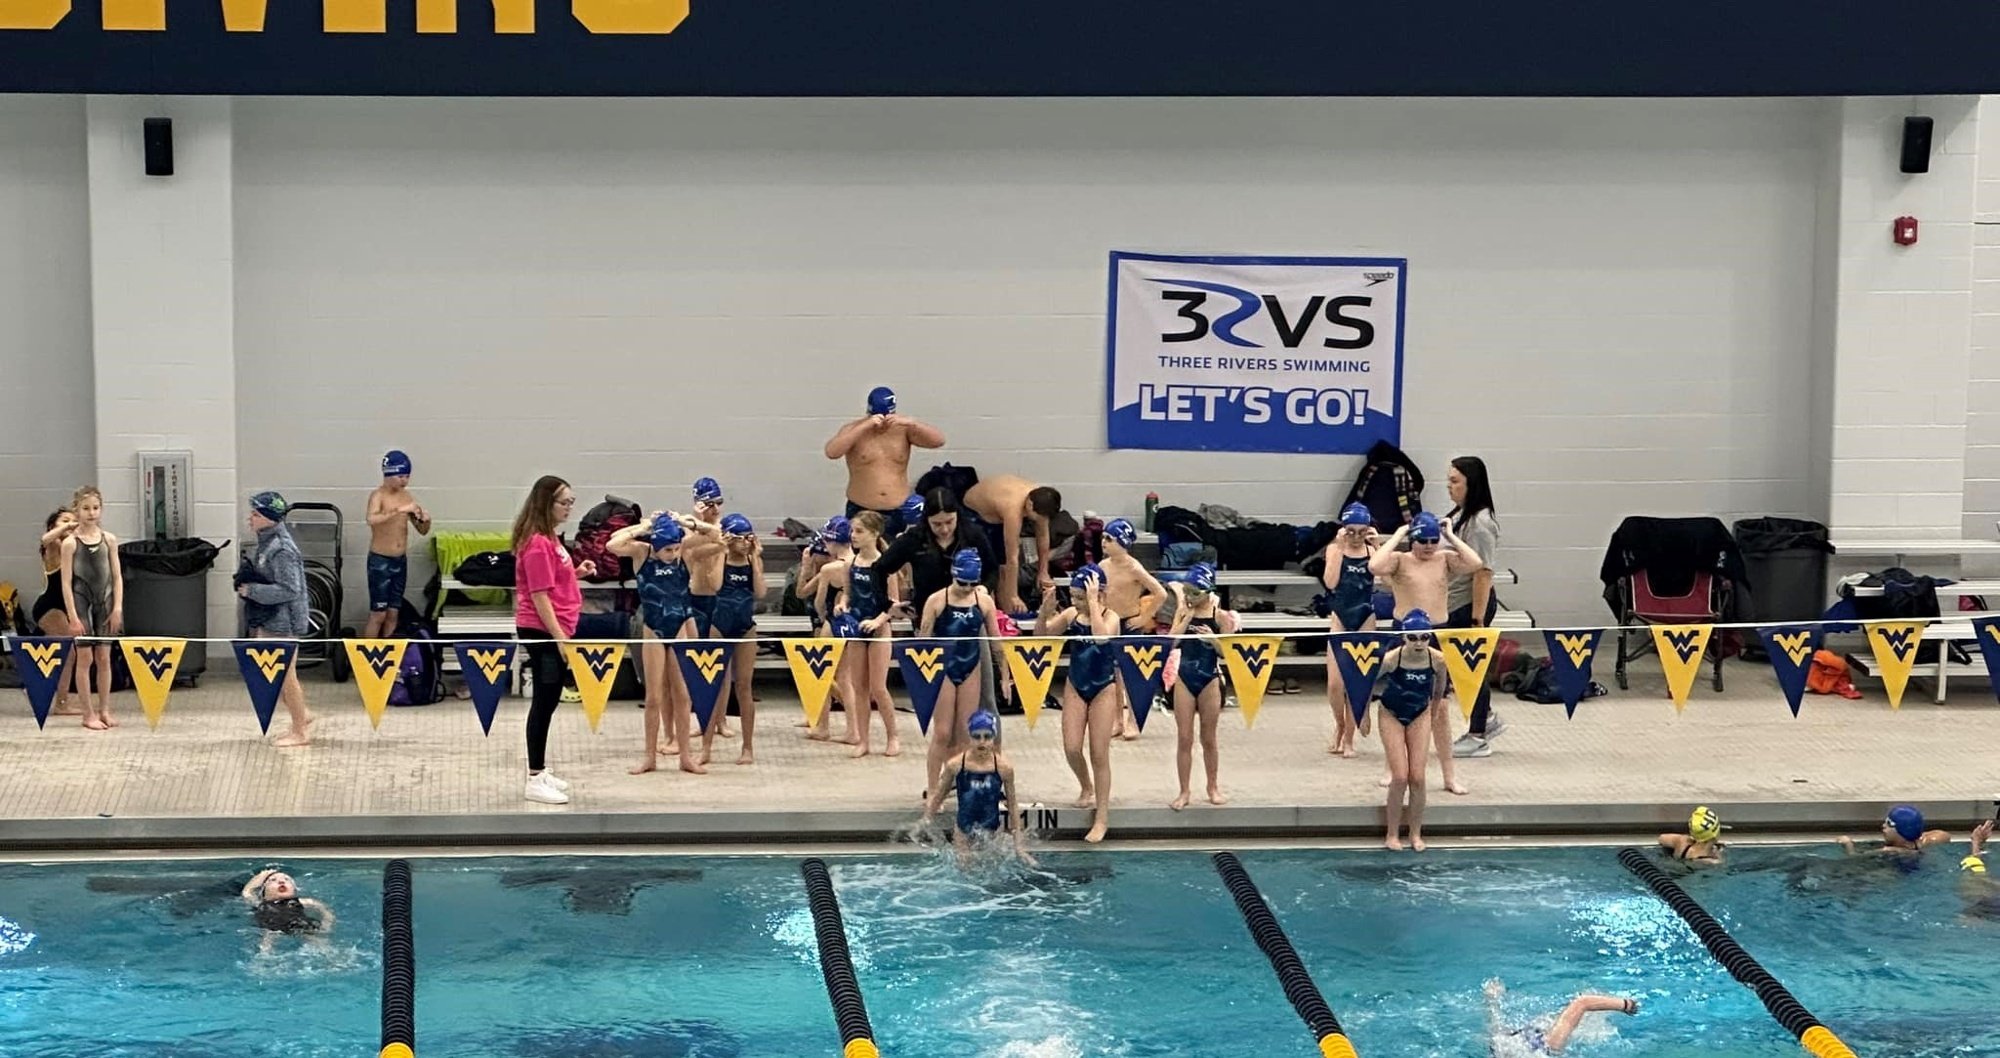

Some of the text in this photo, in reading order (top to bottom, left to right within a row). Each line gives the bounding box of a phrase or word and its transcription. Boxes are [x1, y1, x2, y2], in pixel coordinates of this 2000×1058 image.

[1363, 271, 1395, 281] speedo
[1158, 355, 1371, 373] THREE RIVERS SWIMMING
[1139, 383, 1370, 426] LET'S GO!
[1037, 809, 1058, 829] IN
